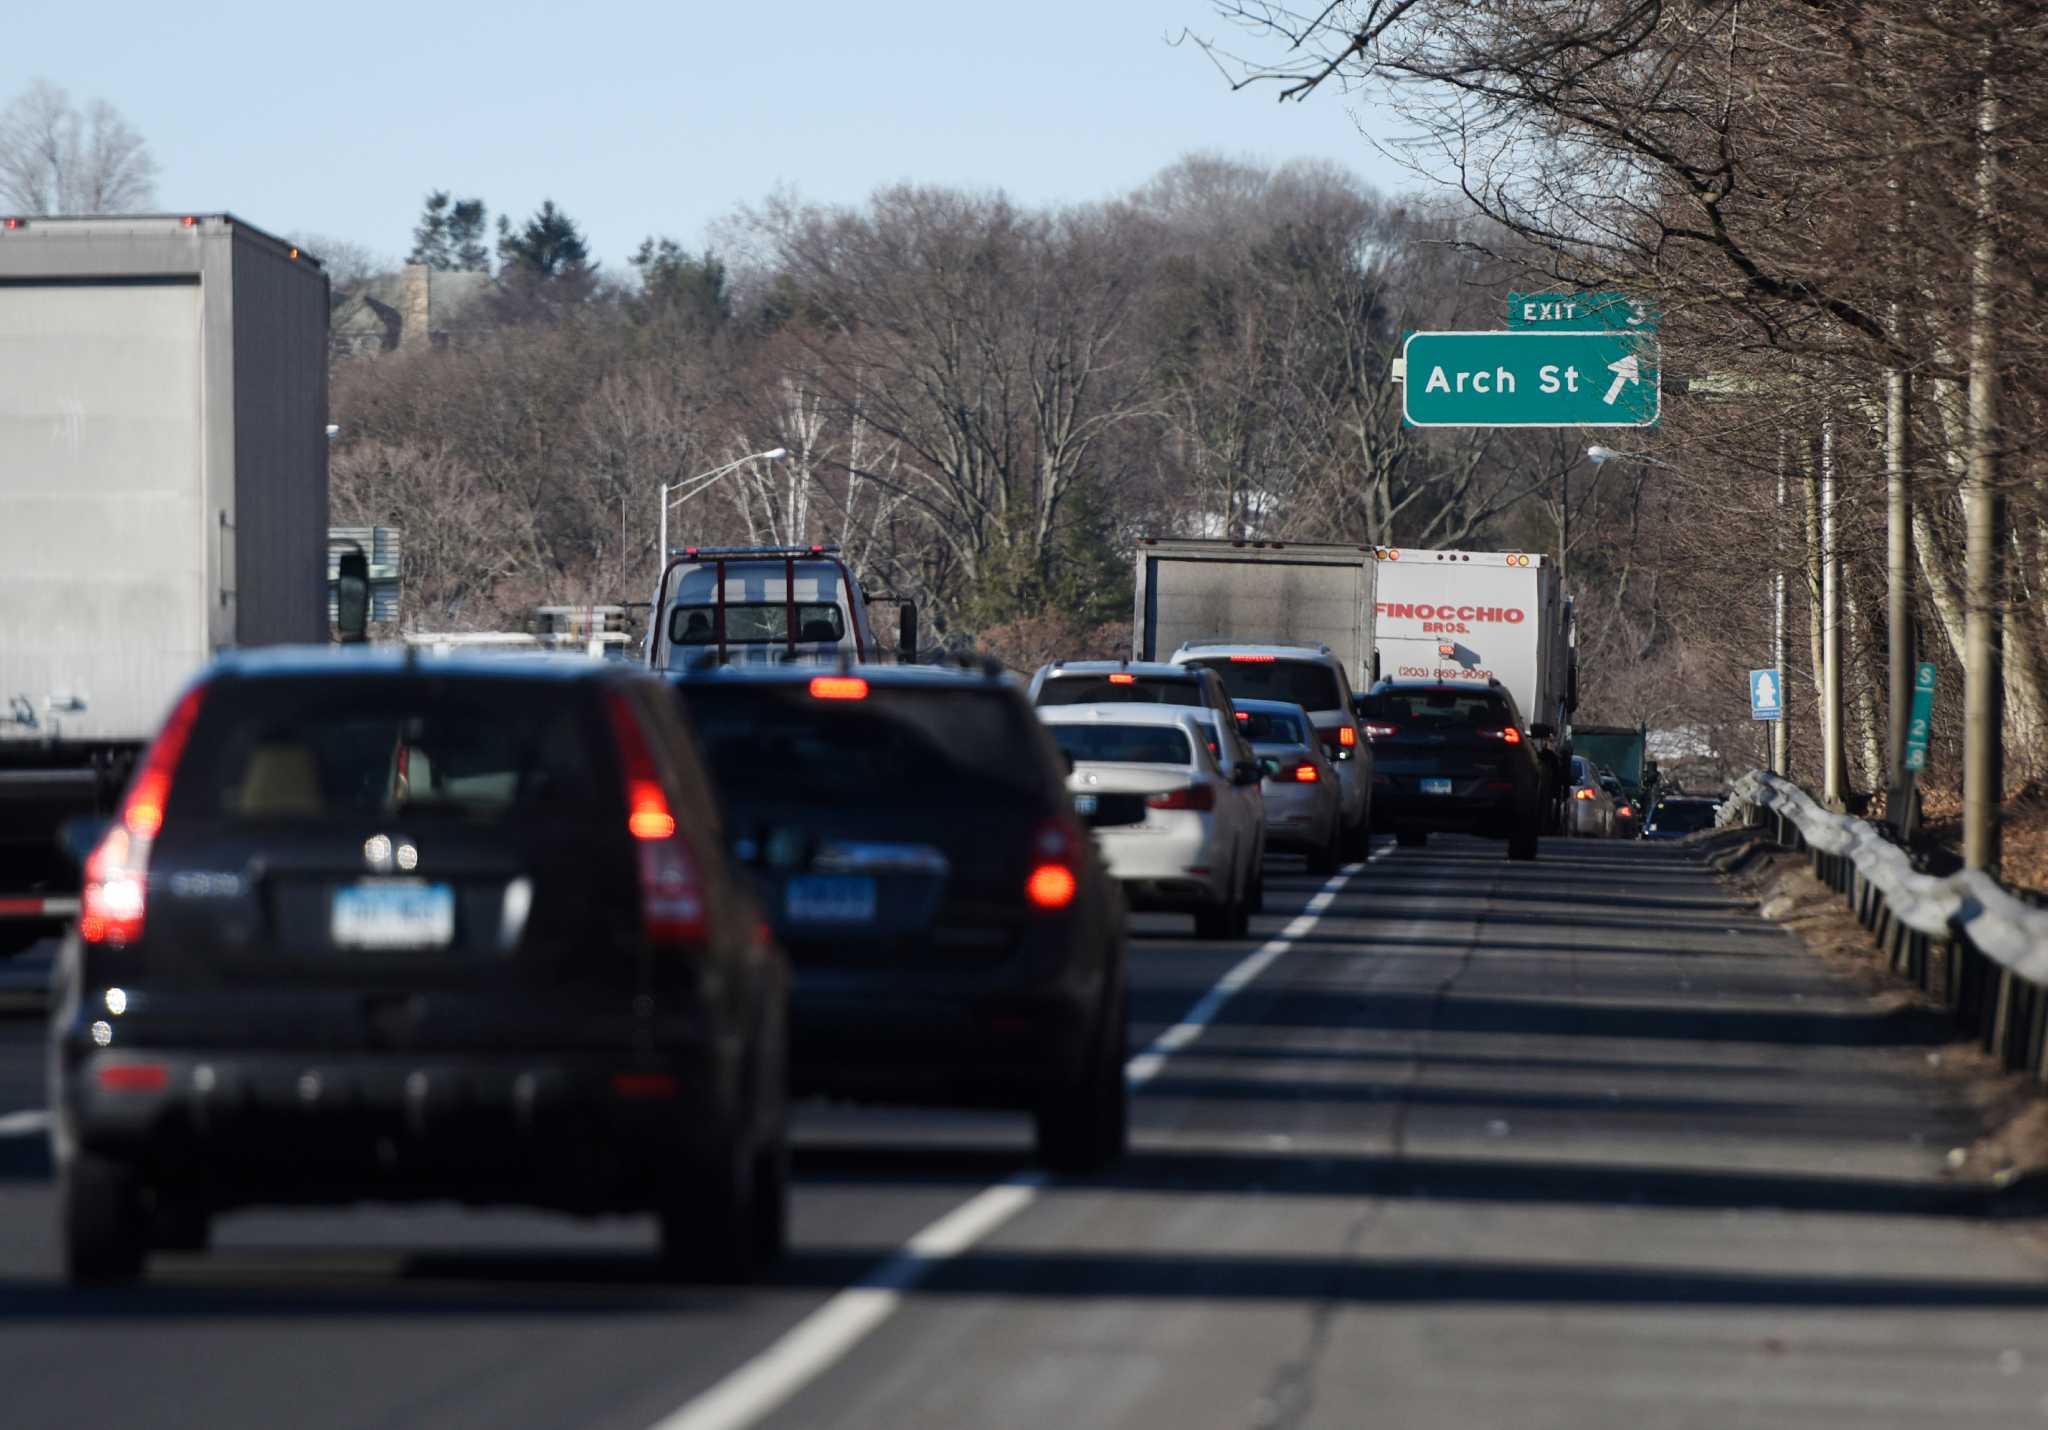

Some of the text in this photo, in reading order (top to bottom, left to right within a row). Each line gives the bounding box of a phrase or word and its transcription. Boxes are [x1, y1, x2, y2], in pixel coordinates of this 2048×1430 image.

[1523, 303, 1577, 320] EXIT
[1425, 365, 1579, 393] Arch St
[1423, 622, 1471, 634] BROS.
[1398, 666, 1429, 678] (203)
[1911, 718, 1926, 736] 2
